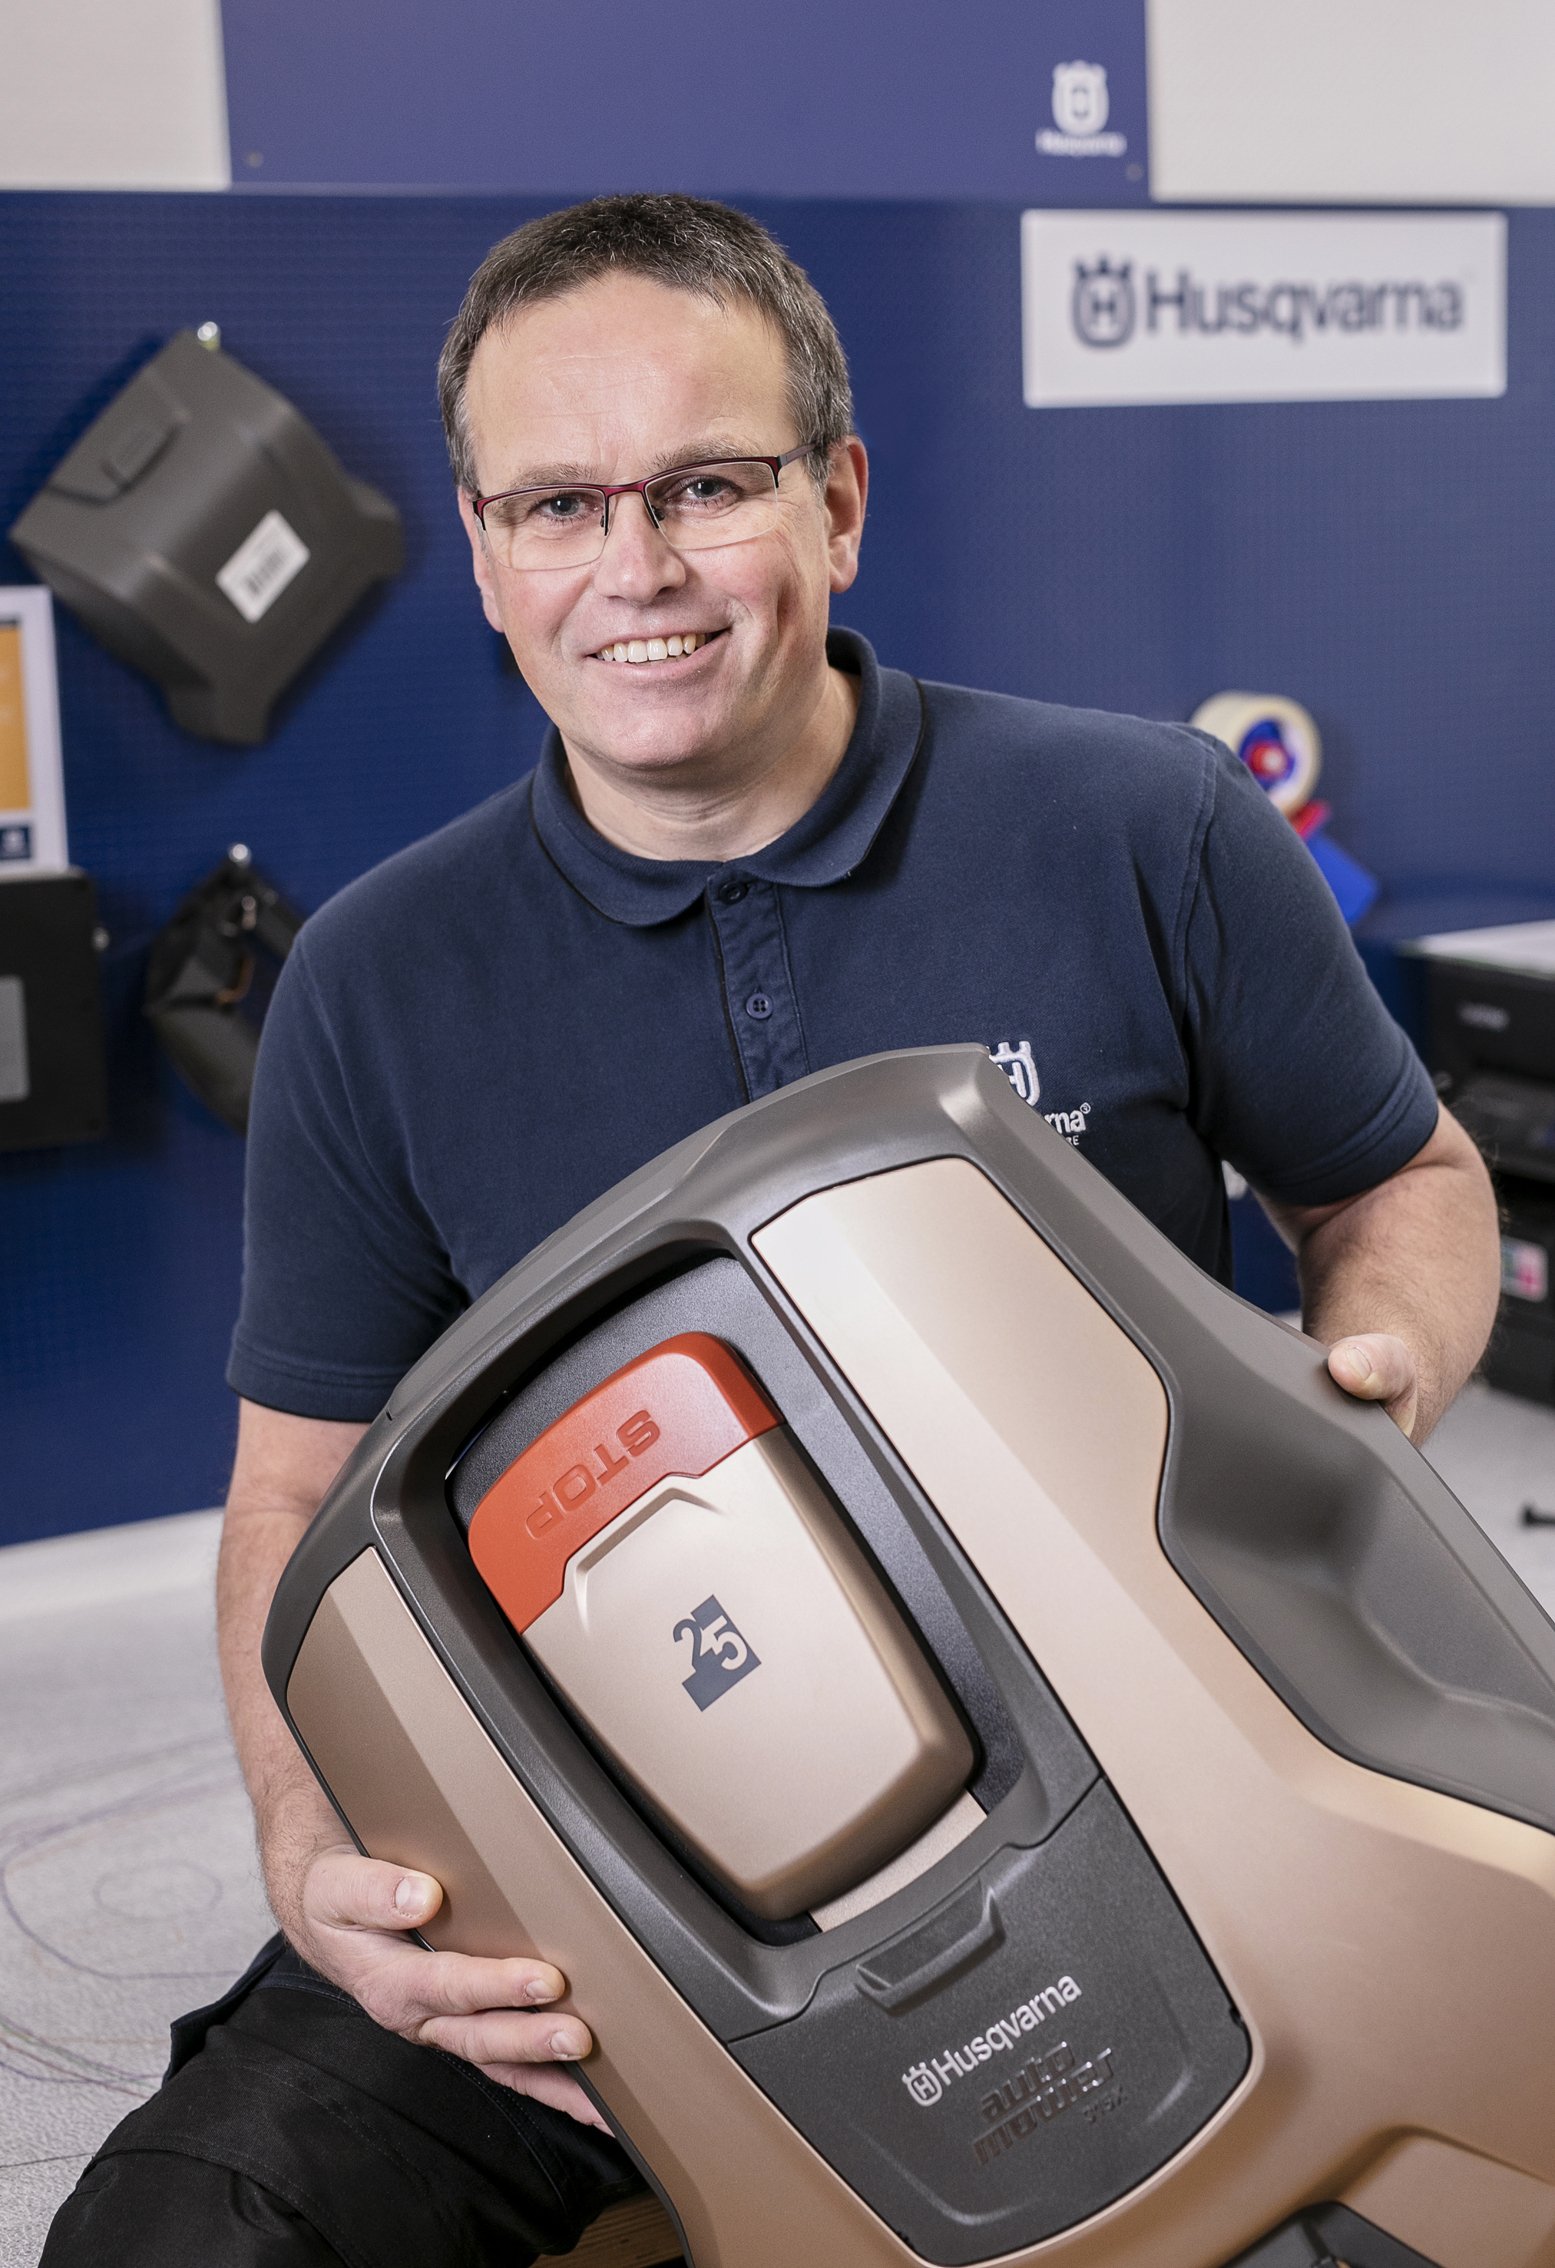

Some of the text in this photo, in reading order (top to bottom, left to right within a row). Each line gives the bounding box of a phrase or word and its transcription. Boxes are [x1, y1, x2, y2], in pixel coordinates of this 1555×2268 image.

[1145, 267, 1464, 348] Husqvarna
[524, 1409, 661, 1540] STOP
[672, 1614, 749, 1672] 25
[930, 1975, 1082, 2086] Husqvarna
